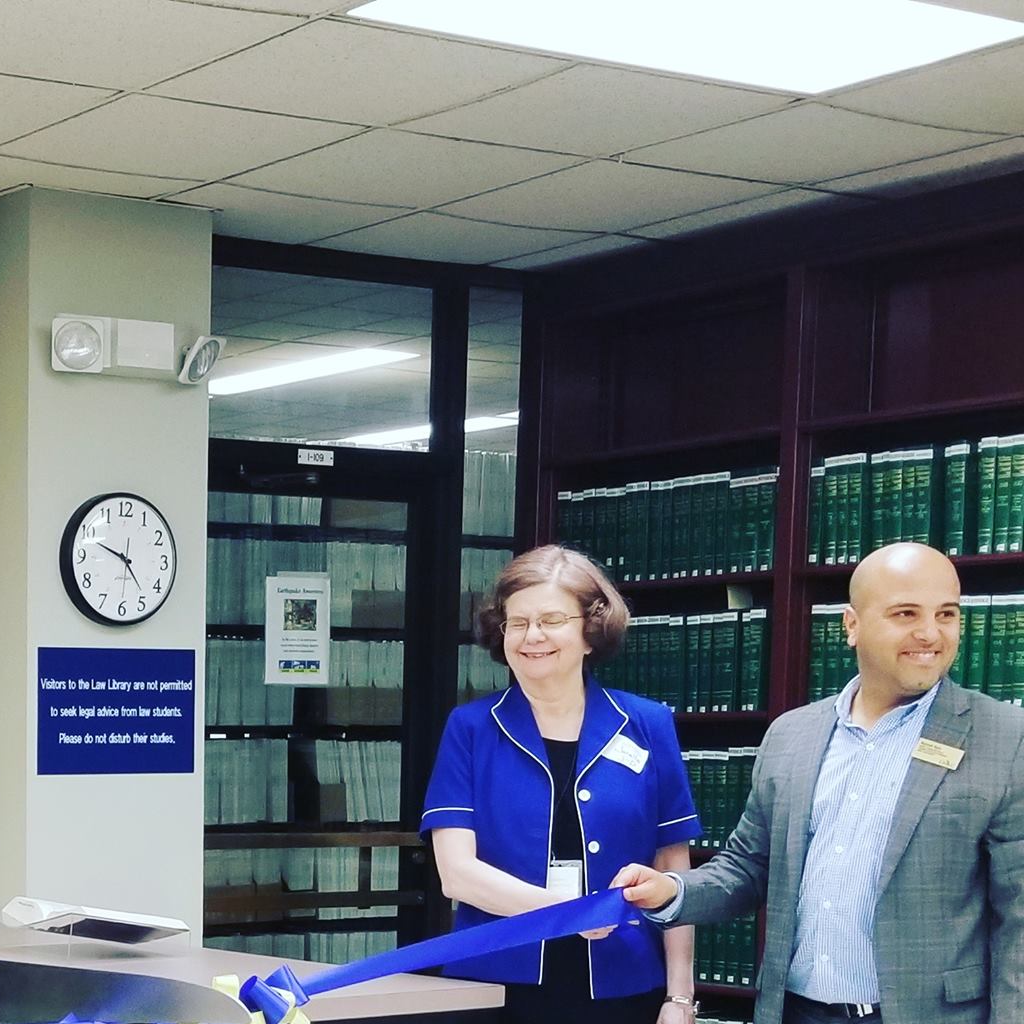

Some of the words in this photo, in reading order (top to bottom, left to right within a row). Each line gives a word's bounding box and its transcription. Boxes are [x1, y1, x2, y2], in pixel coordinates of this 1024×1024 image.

[101, 508, 112, 523] 11
[118, 502, 134, 518] 12
[140, 511, 147, 527] 1
[82, 524, 96, 540] 10
[154, 531, 164, 546] 2
[77, 549, 86, 564] 9
[160, 555, 169, 571] 3
[82, 573, 92, 589] 8
[152, 578, 162, 594] 4
[98, 594, 108, 610] 7
[118, 601, 126, 616] 6
[137, 596, 146, 612] 5
[41, 678, 67, 690] Visitors
[69, 679, 77, 690] to
[78, 679, 90, 690] the
[91, 679, 106, 690] Law
[108, 679, 132, 692] Library
[133, 681, 145, 690] are
[147, 680, 158, 690] not
[160, 680, 193, 693] permitted
[51, 706, 59, 717] to
[60, 706, 77, 717] seek
[79, 706, 96, 719] legal
[97, 706, 119, 717] advice
[121, 706, 137, 717] from
[139, 706, 151, 717] law
[153, 706, 182, 717] students.
[59, 732, 83, 744] Please
[84, 733, 94, 744] do
[95, 733, 107, 744] not
[109, 732, 131, 744] disturb
[133, 732, 148, 744] their
[150, 733, 176, 744] studies.
